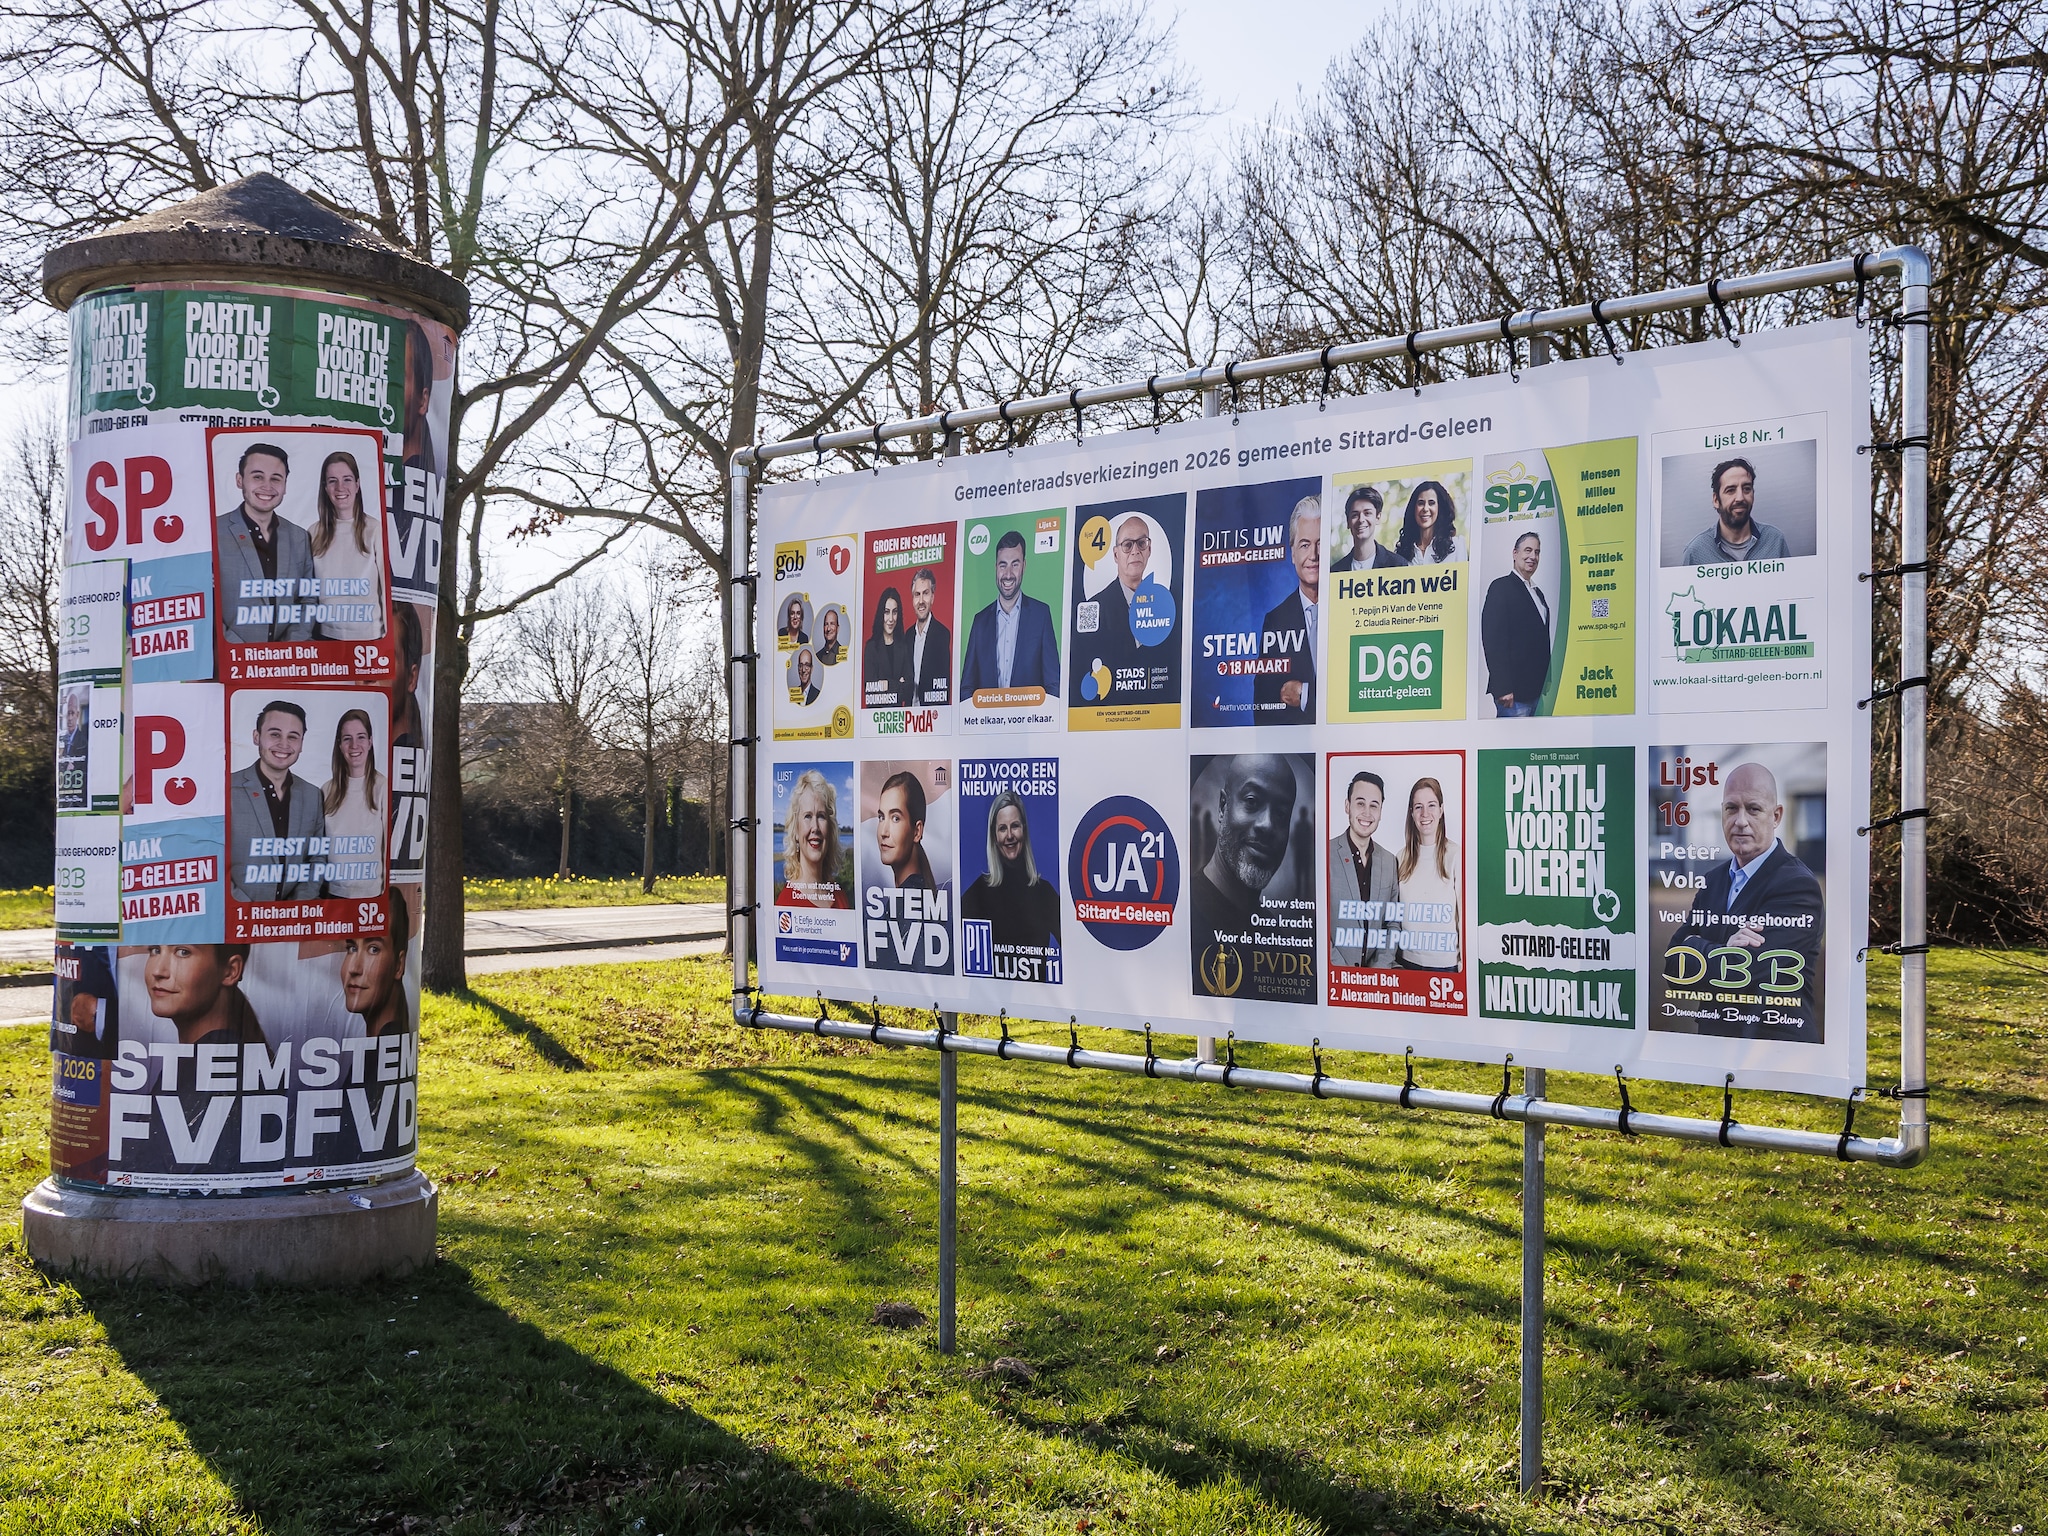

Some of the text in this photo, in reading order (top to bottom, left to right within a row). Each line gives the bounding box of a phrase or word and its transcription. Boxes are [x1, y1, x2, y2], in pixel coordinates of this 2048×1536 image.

[186, 301, 271, 336] PARTIJ
[318, 312, 390, 356] PARTIJ
[186, 332, 269, 362] VOOR DE
[318, 342, 388, 380] VOOR DE
[184, 357, 270, 391] DIEREN
[316, 367, 389, 408] DIEREN
[1704, 426, 1784, 450] Lijst 8 Nr. 1
[954, 416, 1492, 501] Gemeenteraadsverkiezingen 2026 gemeente Sittard-Geleen
[1580, 468, 1621, 482] Mensen
[1484, 480, 1555, 514] SPA
[1585, 486, 1616, 498] Milieu
[1576, 502, 1624, 516] Middelen
[873, 532, 946, 554] GROEN EN SOCIAAL
[970, 534, 988, 544] CDA
[1203, 525, 1284, 551] DIT IS UW
[775, 550, 804, 581] gob
[876, 546, 942, 570] SITTARD-GELEEN
[1202, 546, 1284, 566] SITTARD-GELEEN!
[1580, 552, 1624, 564] Politiek
[1588, 568, 1615, 578] naar
[1696, 560, 1785, 579] Sergio Klein
[239, 578, 296, 599] EERST
[297, 577, 321, 598] DE
[324, 577, 370, 597] MENS
[1339, 569, 1458, 600] Het kan wél
[1586, 582, 1617, 592] wens
[236, 603, 376, 626] DAN DE POLITIEK
[1136, 608, 1154, 618] WIL
[1352, 602, 1443, 616] 1. Pepijn Pi Van de Venne
[1136, 618, 1170, 628] PAAUWE
[1364, 618, 1390, 626] Claudia
[1392, 614, 1438, 625] Reiner-Pibiri
[1578, 622, 1626, 631] www.spa-sg.nl
[1674, 604, 1807, 646] LOKAAL
[1203, 629, 1305, 657] STEM PVV
[1712, 645, 1807, 660] SITTARD-GELEEN-BORN
[1230, 659, 1290, 674] 18 MAART
[1358, 642, 1433, 683] D66
[1116, 668, 1145, 679] STADS
[1580, 666, 1614, 680] Jack
[1652, 670, 1822, 686] www.lokaal-sittard-geleen-born.nl
[932, 678, 948, 690] PAUL
[1116, 680, 1146, 691] PARTIJ
[1358, 686, 1432, 700] sittard-geleen
[1576, 684, 1618, 699] Renet
[924, 690, 948, 702] KUBBEN
[978, 693, 1040, 703] Patrick Brouwers
[1260, 702, 1286, 710] VRIJHEID
[872, 710, 904, 722] GROEN
[905, 710, 933, 733] PvdA
[964, 714, 1054, 726] Met elkaar, voor elkaar.
[878, 722, 904, 734] LINKS
[1530, 752, 1580, 762] Stem 18 maart
[777, 770, 793, 782] LIJST
[961, 762, 1056, 778] TIJD VOOR EEN
[1658, 756, 1720, 792] Lijst
[777, 784, 784, 798] 9
[962, 780, 1056, 796] NIEUWE KOERS
[1504, 764, 1606, 812] PARTIJ
[1658, 801, 1691, 828] 16
[1504, 810, 1606, 851] VOOR DE
[1659, 842, 1722, 860] Peter
[1504, 849, 1606, 898] DIEREN
[1658, 870, 1708, 890] Vola
[866, 886, 948, 921] STEM
[1260, 896, 1315, 910] Jouw stem
[1338, 900, 1452, 924] EERST DE MENS
[1078, 903, 1170, 923] Sittard-Geleen
[1250, 913, 1313, 928] Onze kracht
[1658, 910, 1814, 928] Voel jij je nog gehoord?
[868, 918, 950, 967] FVD
[1214, 930, 1314, 948] Voor de Rechtsstaat
[1334, 926, 1458, 952] DAN DE POLITIEK
[1500, 934, 1611, 962] SITTARD-GELEEN
[994, 944, 1060, 956] MAUD SCHENK NR.1
[994, 956, 1060, 982] LIJST 11
[1252, 950, 1314, 976] PVDR
[1661, 946, 1806, 993] DBB
[1254, 976, 1310, 988] PARTIJ VOOR DE
[1330, 970, 1400, 988] 1. Richard Bok
[1258, 985, 1306, 996] RECHTSSTAAT
[1330, 988, 1426, 1007] 2. Alexandra Didden
[1485, 974, 1630, 1022] NATUURLIJK.
[1664, 990, 1802, 1008] SITTARD GELEEN BORN
[111, 1040, 292, 1091] STEM
[299, 1032, 417, 1086] STEM
[64, 1058, 96, 1080] 2026
[108, 1094, 290, 1164] FVD
[294, 1082, 417, 1158] FVD
